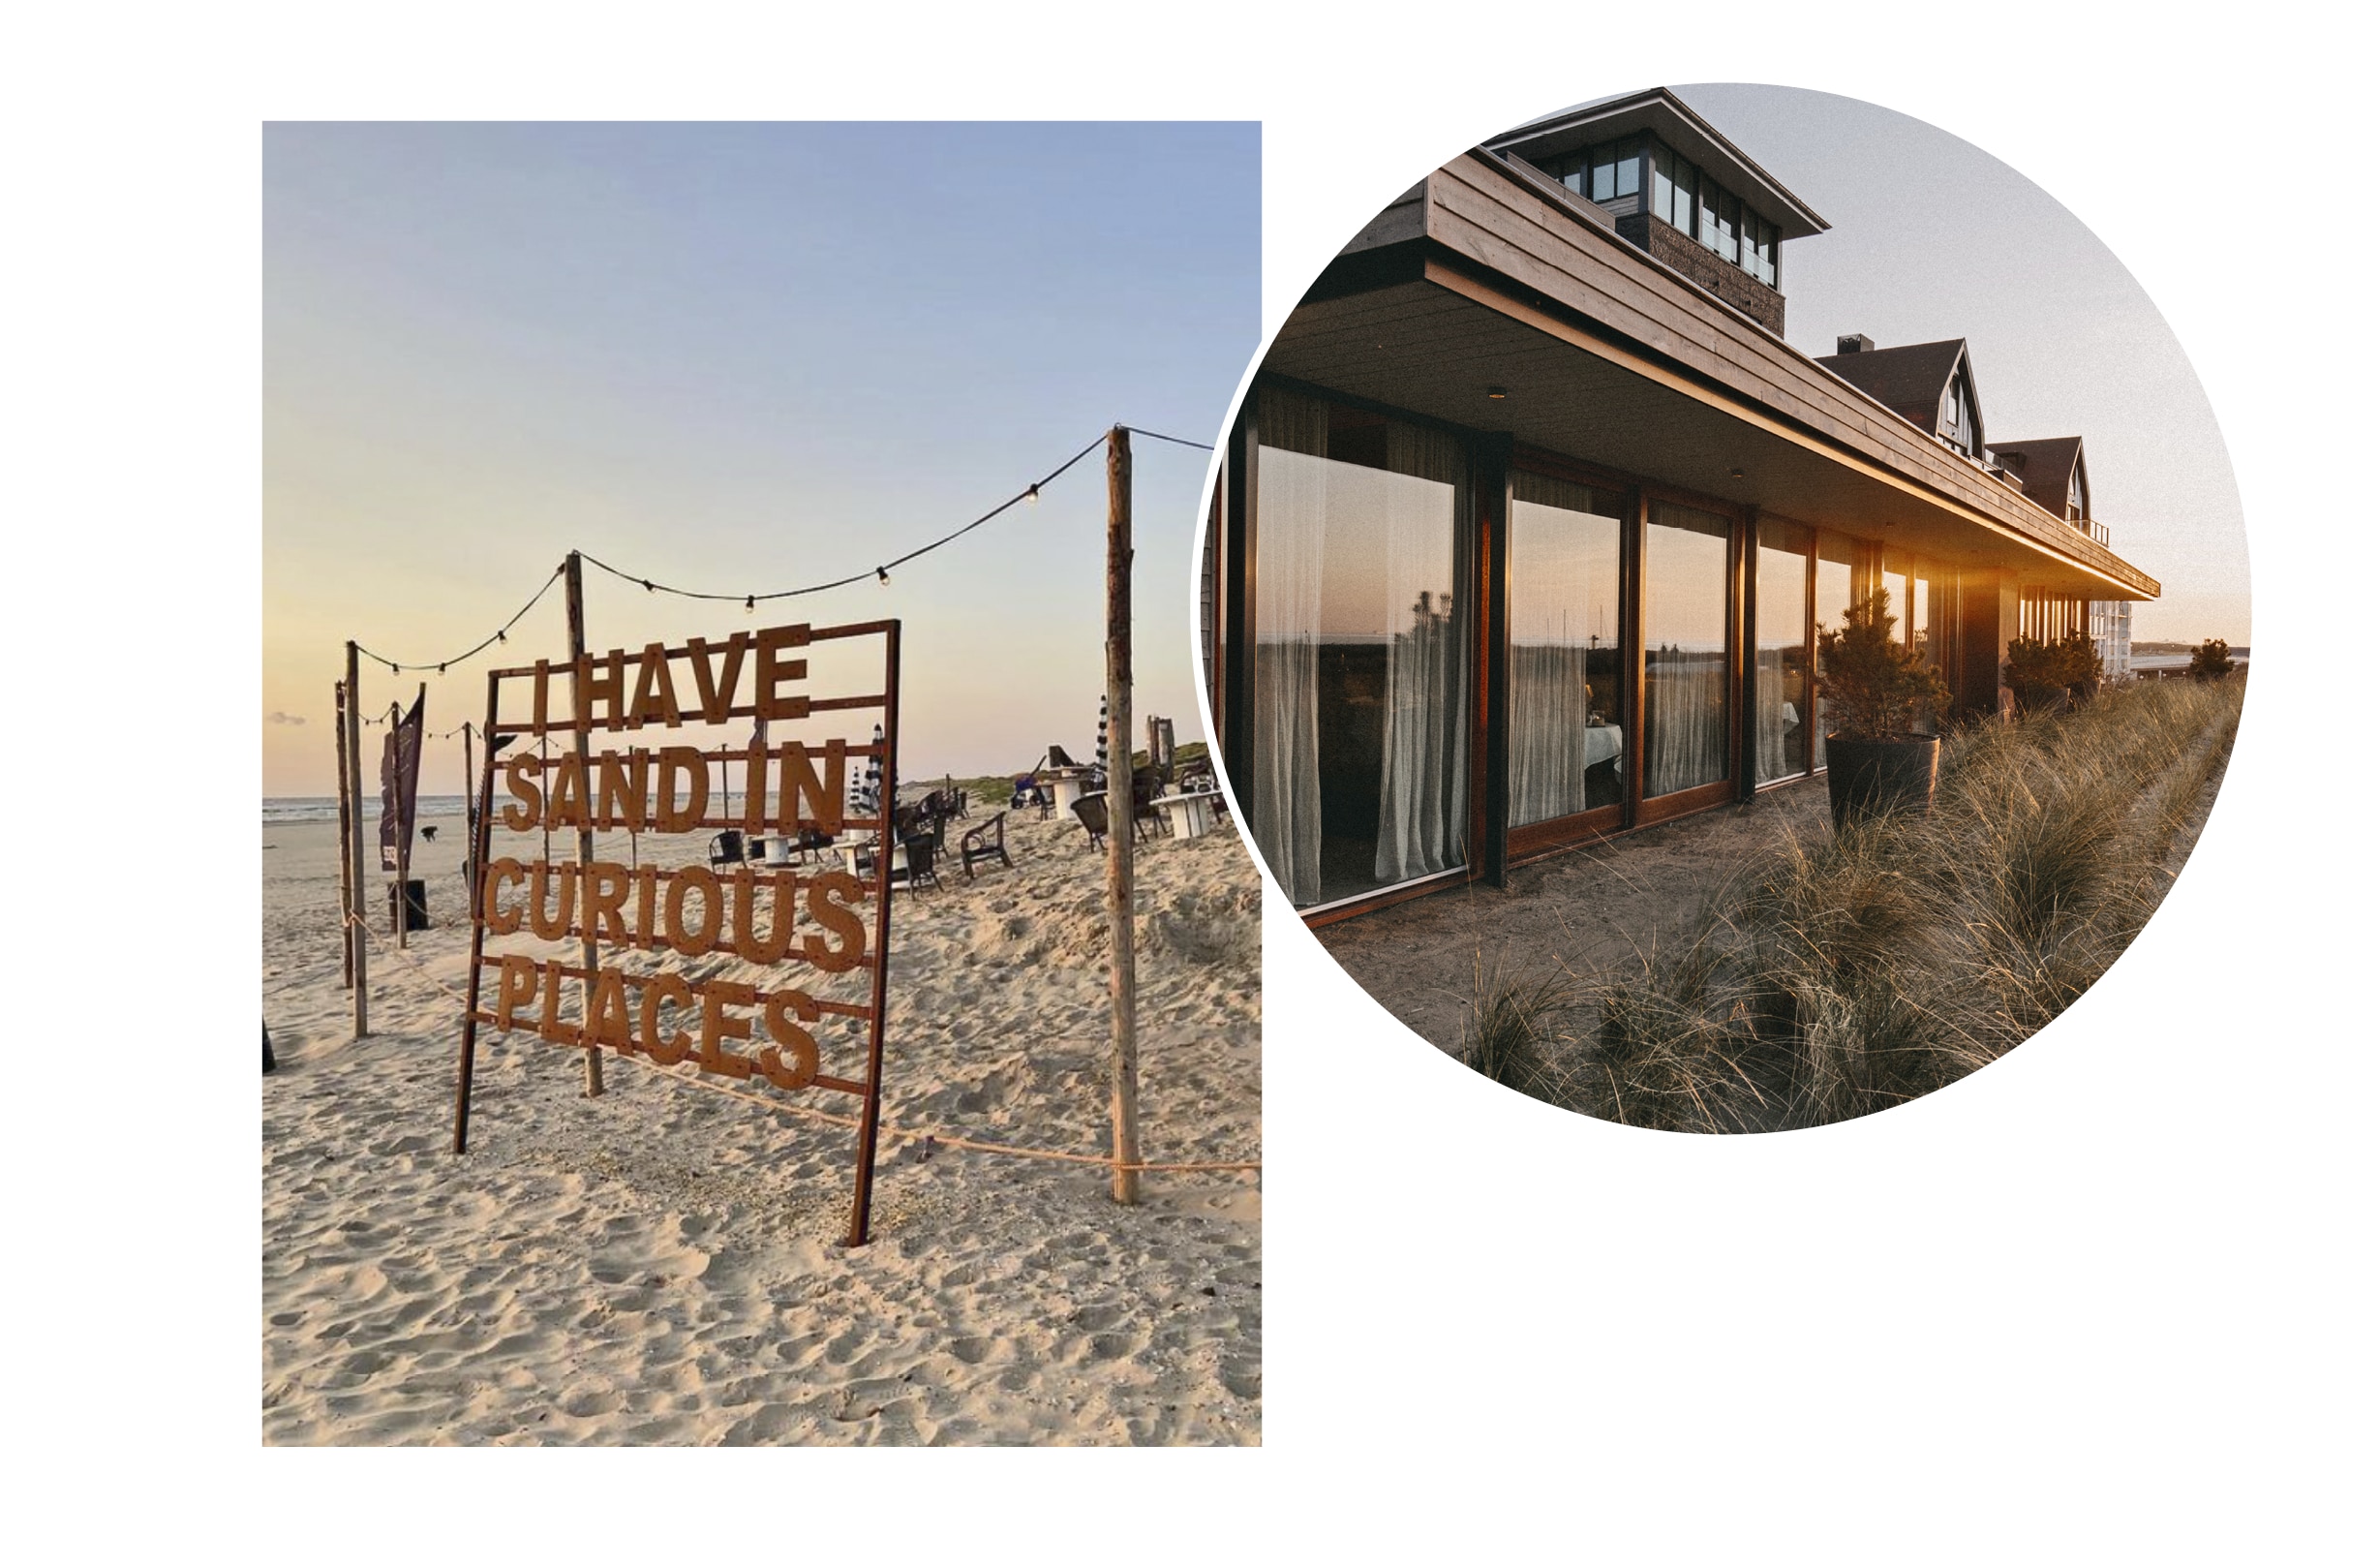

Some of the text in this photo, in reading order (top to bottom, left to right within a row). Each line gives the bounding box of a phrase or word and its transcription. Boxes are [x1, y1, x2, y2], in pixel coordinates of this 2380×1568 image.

[533, 623, 810, 736] I HAVE
[503, 738, 846, 836] SAND IN
[485, 856, 866, 971] CURIOUS
[497, 953, 820, 1091] PLACES
